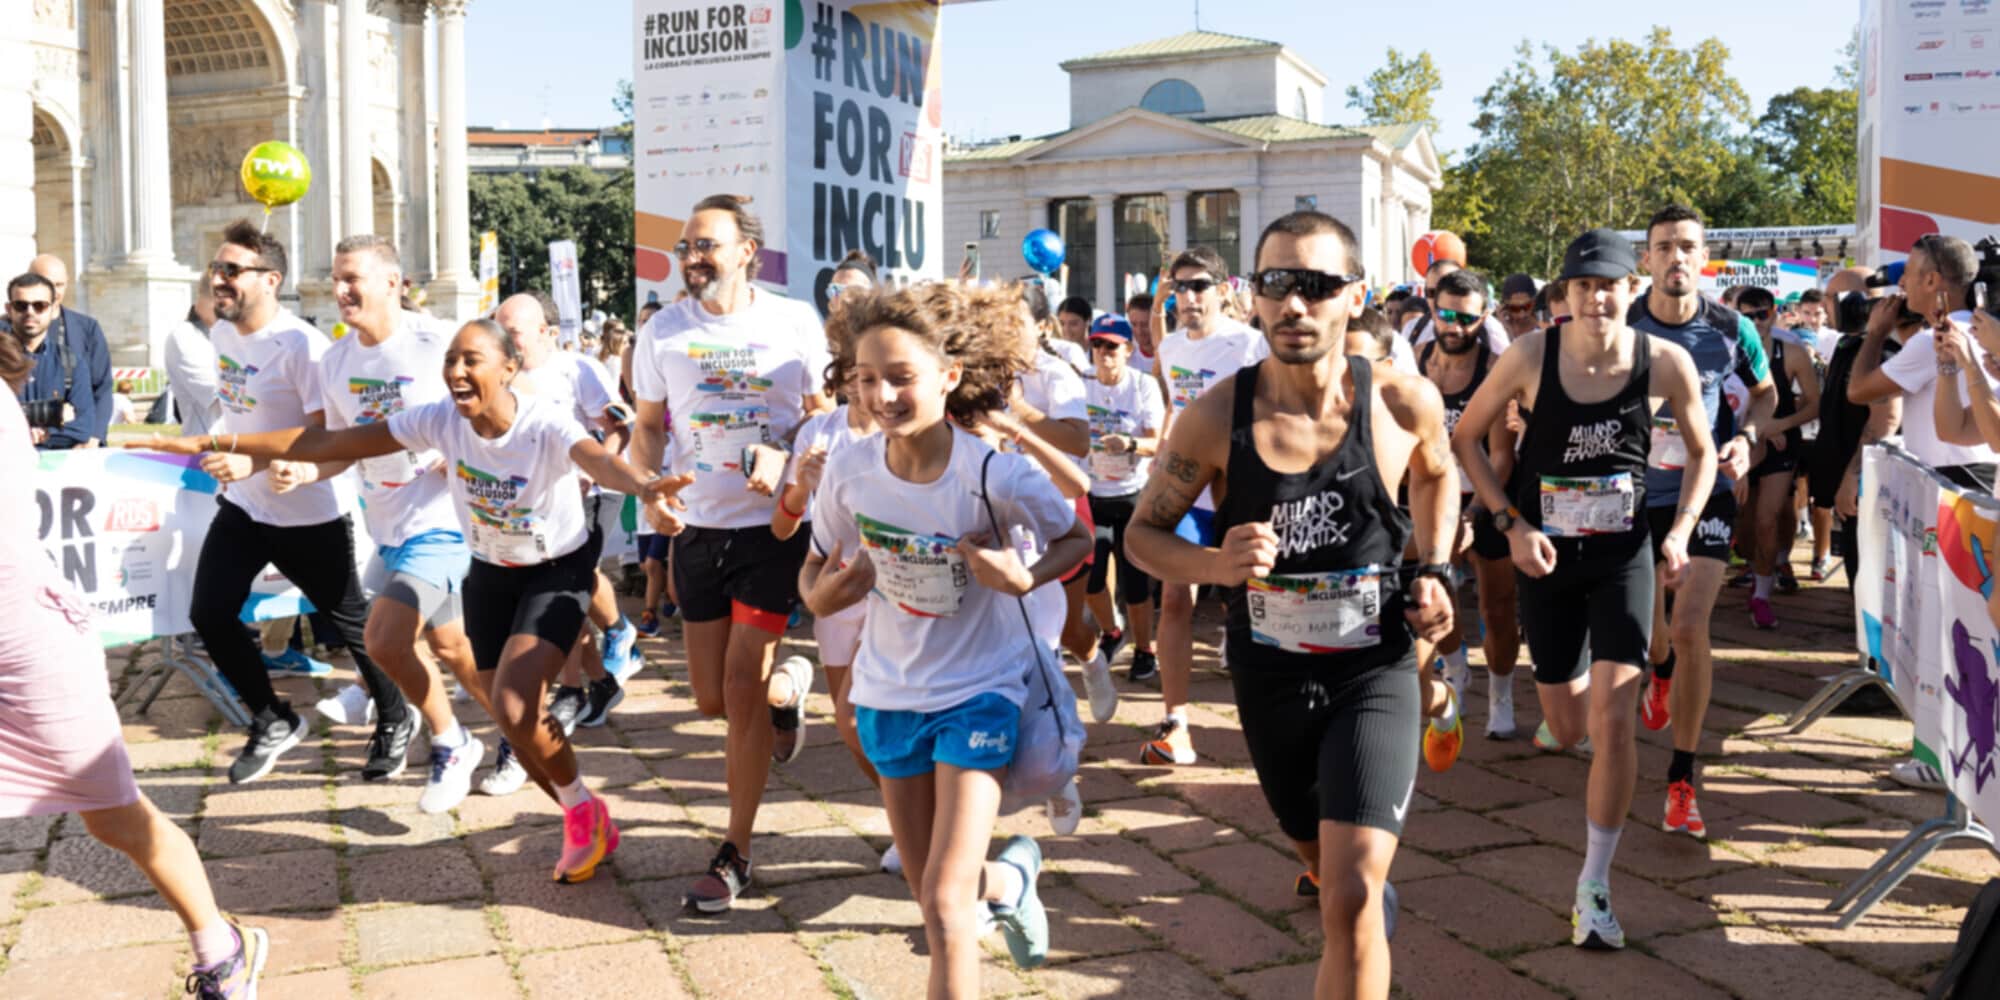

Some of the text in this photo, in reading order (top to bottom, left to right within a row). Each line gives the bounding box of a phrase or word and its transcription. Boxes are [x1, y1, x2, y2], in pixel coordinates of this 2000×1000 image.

[644, 9, 699, 36] #RUN
[707, 4, 746, 30] FOR
[644, 28, 748, 60] INCLUSION
[812, 2, 923, 107] #RUN
[813, 90, 894, 184] FOR
[813, 182, 925, 270] INCLU
[1716, 276, 1779, 287] INCLUSION
[1717, 264, 1778, 276] #RUN FOR
[700, 359, 757, 371] INCLUSION
[35, 487, 96, 540] OR
[1270, 491, 1345, 524] MILANO
[90, 594, 158, 614] EMPRE
[1307, 588, 1361, 602] INCLUSION
